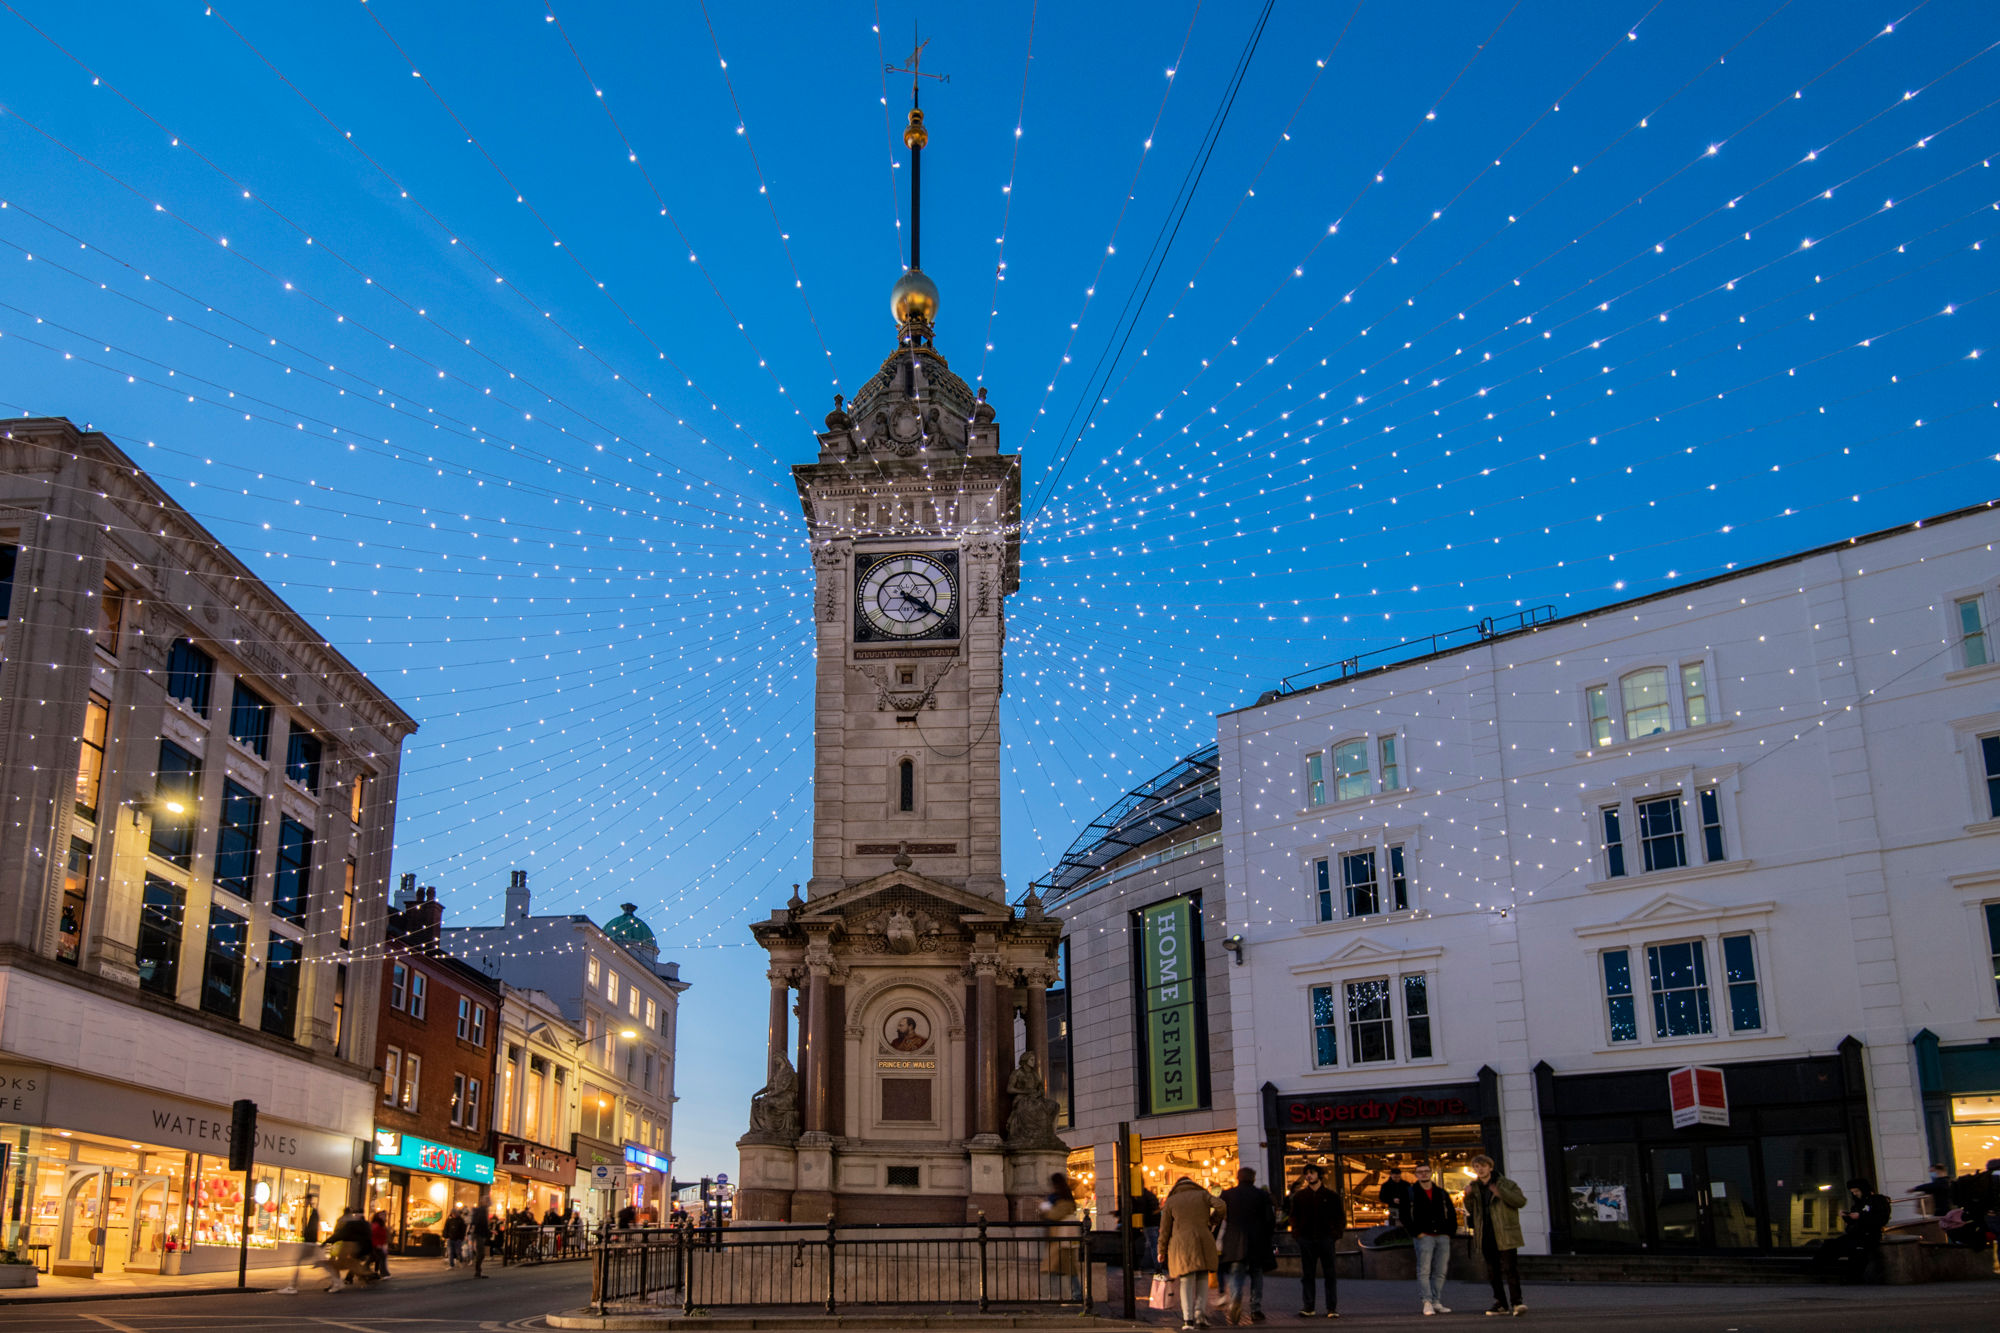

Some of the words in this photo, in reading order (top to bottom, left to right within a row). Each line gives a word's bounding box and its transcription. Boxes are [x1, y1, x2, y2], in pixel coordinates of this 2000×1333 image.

[1158, 912, 1179, 1002] HOME
[878, 1061, 901, 1069] PRINCE
[902, 1061, 912, 1069] OF
[913, 1061, 935, 1070] WALES
[1162, 1010, 1183, 1103] SENSE
[152, 1109, 297, 1155] WATERSONES
[421, 1145, 459, 1173] LEON
